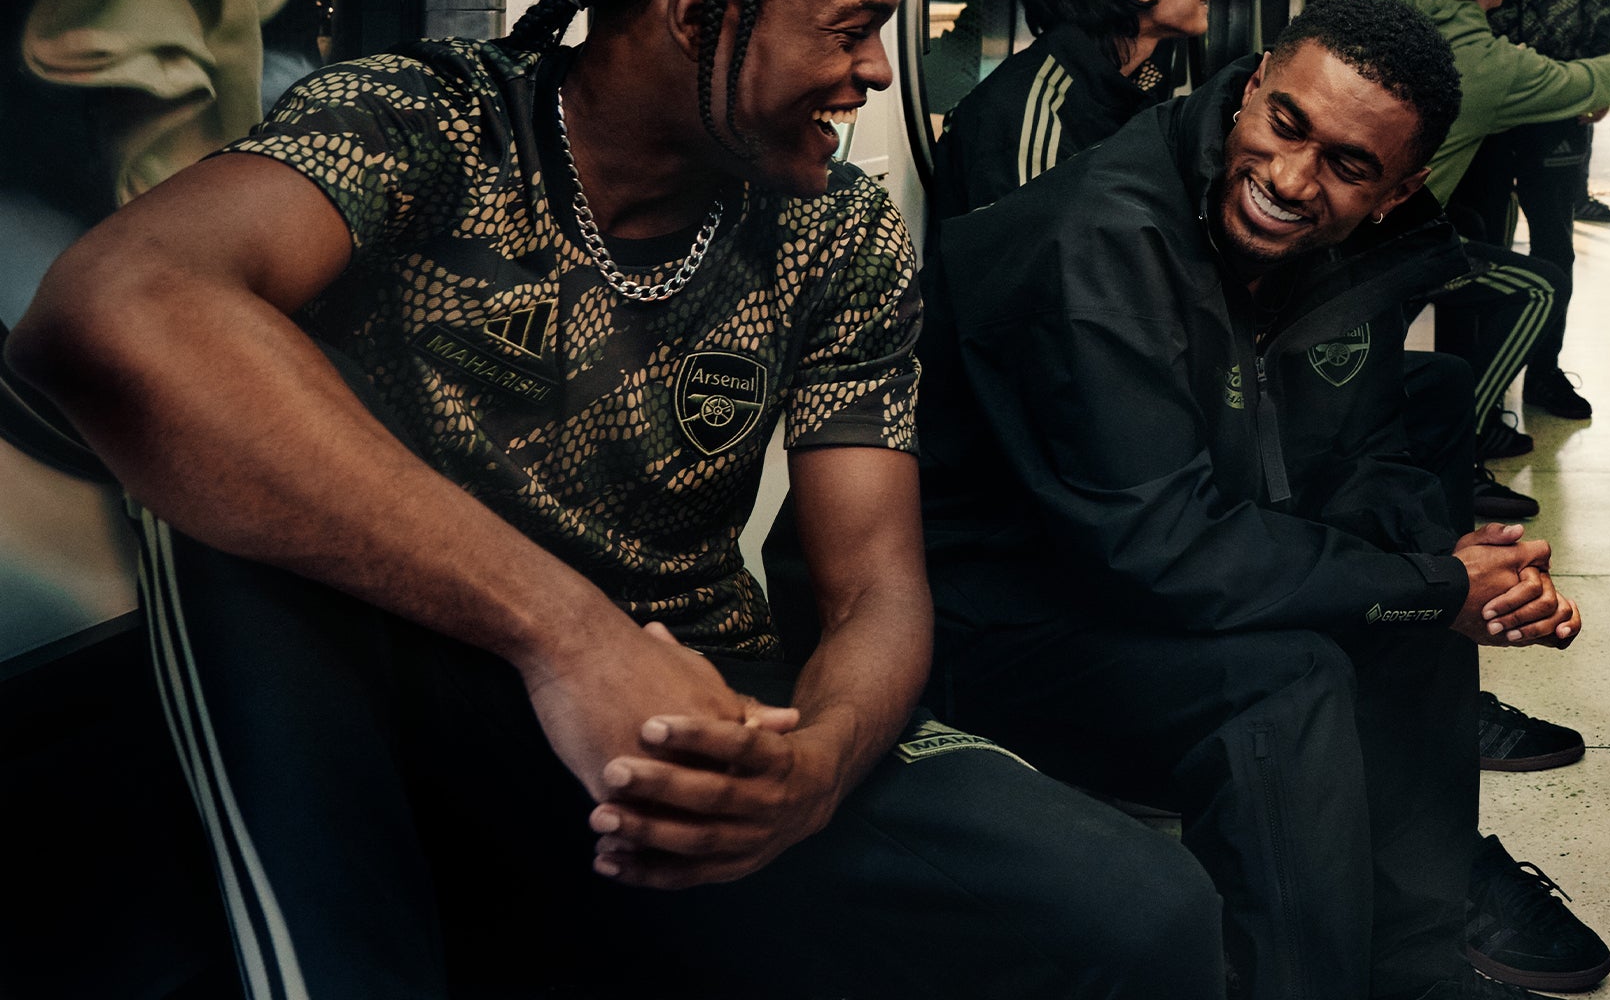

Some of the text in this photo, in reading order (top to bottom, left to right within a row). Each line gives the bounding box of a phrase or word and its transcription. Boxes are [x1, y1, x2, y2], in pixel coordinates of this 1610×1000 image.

[426, 335, 551, 400] MAHARISHI
[691, 368, 755, 391] Arsenal
[1381, 609, 1443, 622] GORE-TEX
